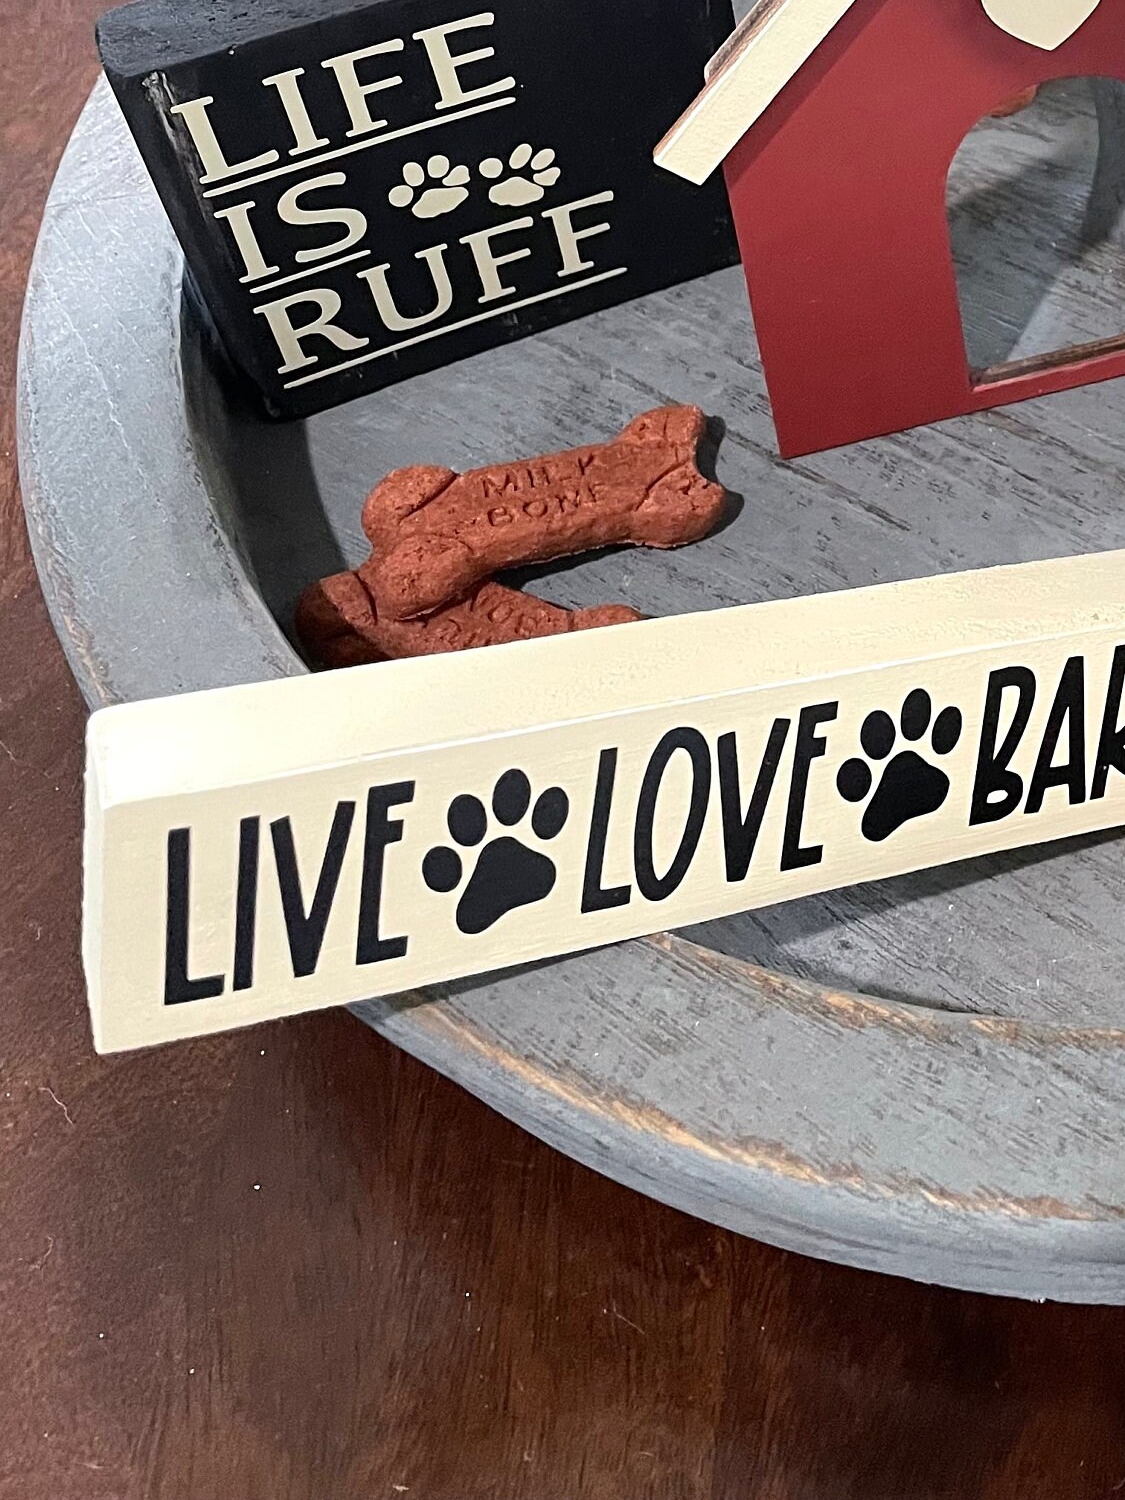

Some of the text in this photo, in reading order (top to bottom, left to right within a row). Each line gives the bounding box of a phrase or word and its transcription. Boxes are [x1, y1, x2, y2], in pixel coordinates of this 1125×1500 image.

[169, 12, 516, 185] LIFE
[213, 171, 368, 284] IS
[252, 190, 614, 374] RUFF
[163, 780, 416, 1006] LIVE
[580, 700, 839, 914] LOVE
